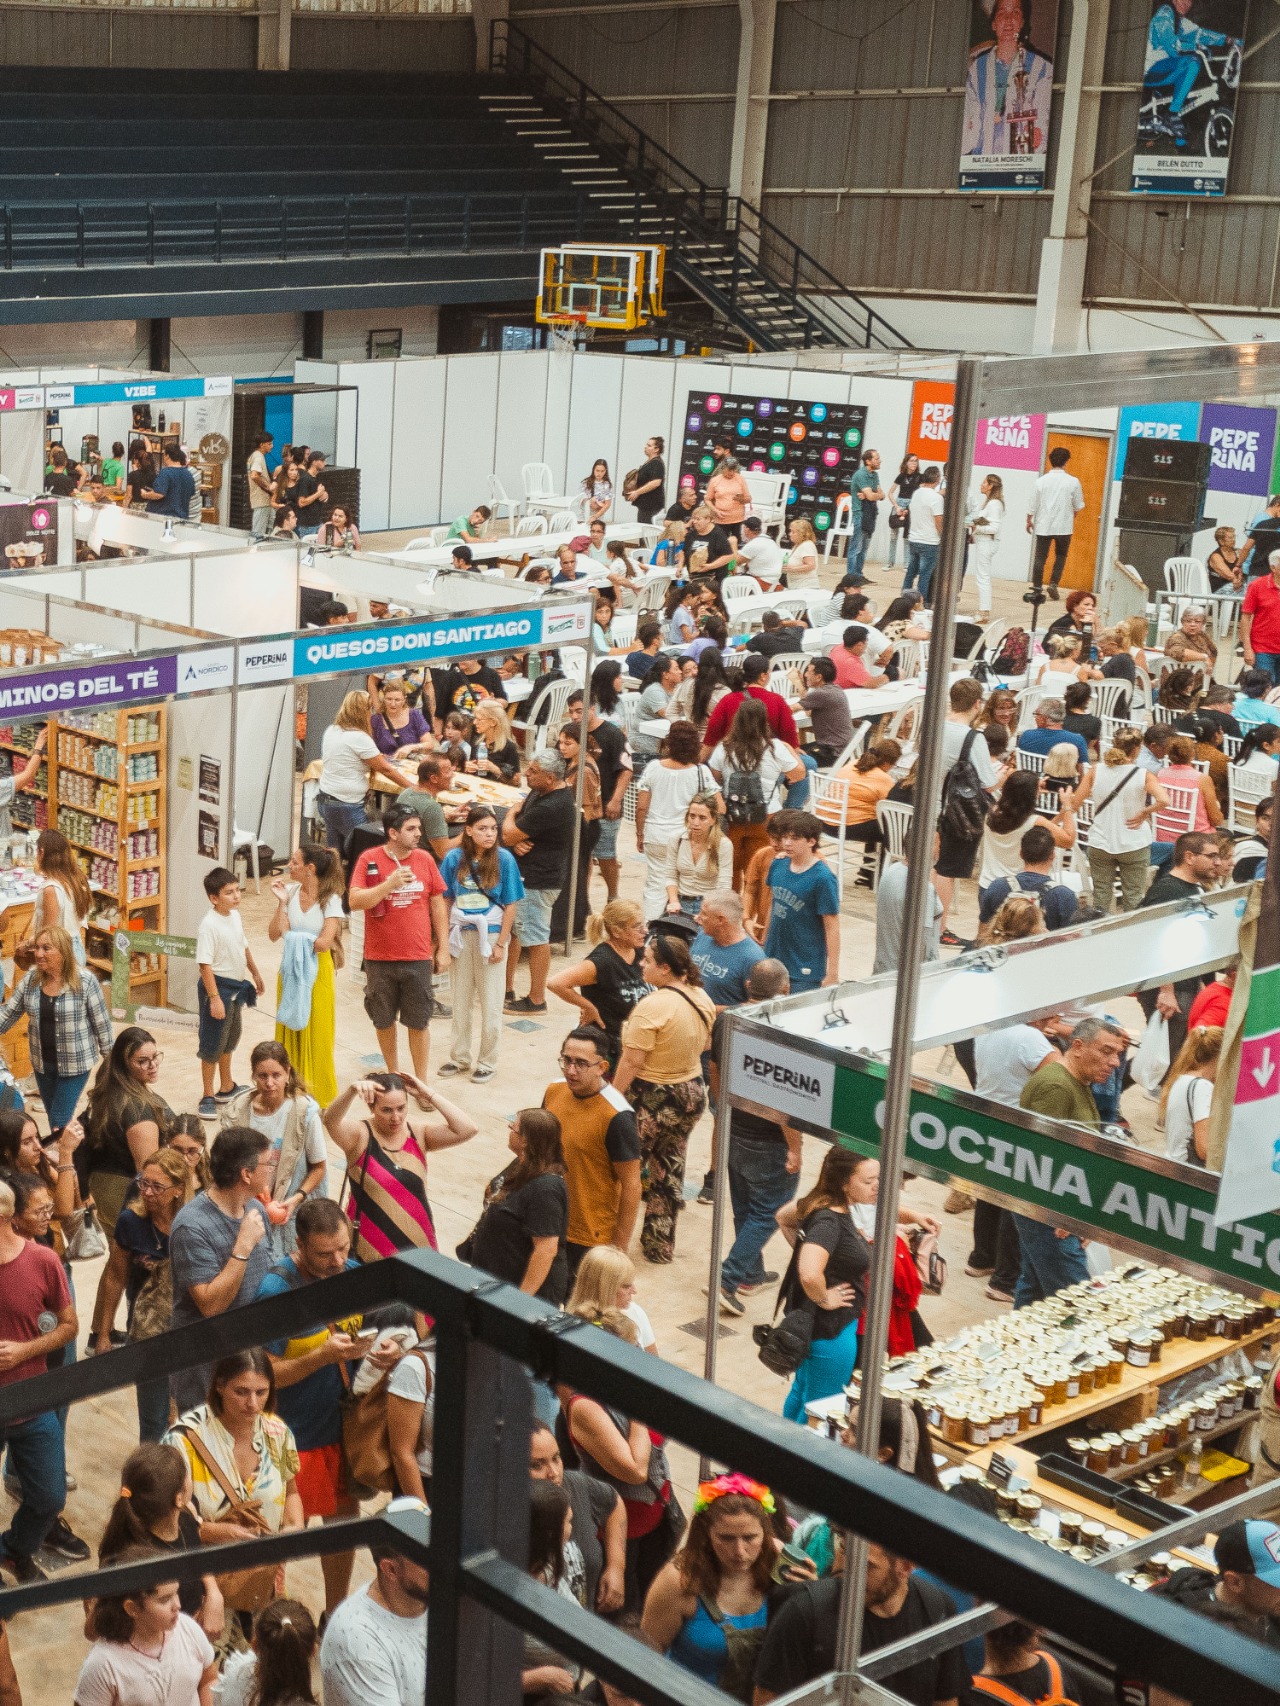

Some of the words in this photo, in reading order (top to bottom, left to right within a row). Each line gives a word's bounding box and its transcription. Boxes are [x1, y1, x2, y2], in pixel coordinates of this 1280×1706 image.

[124, 385, 157, 397] VIBE
[922, 402, 954, 422] PEP
[1209, 427, 1260, 451] PEPE
[306, 637, 390, 665] QUESOS
[391, 631, 432, 652] DON
[433, 619, 531, 646] SANTIAGO
[78, 676, 124, 698] DEL
[127, 666, 159, 690] TÉ
